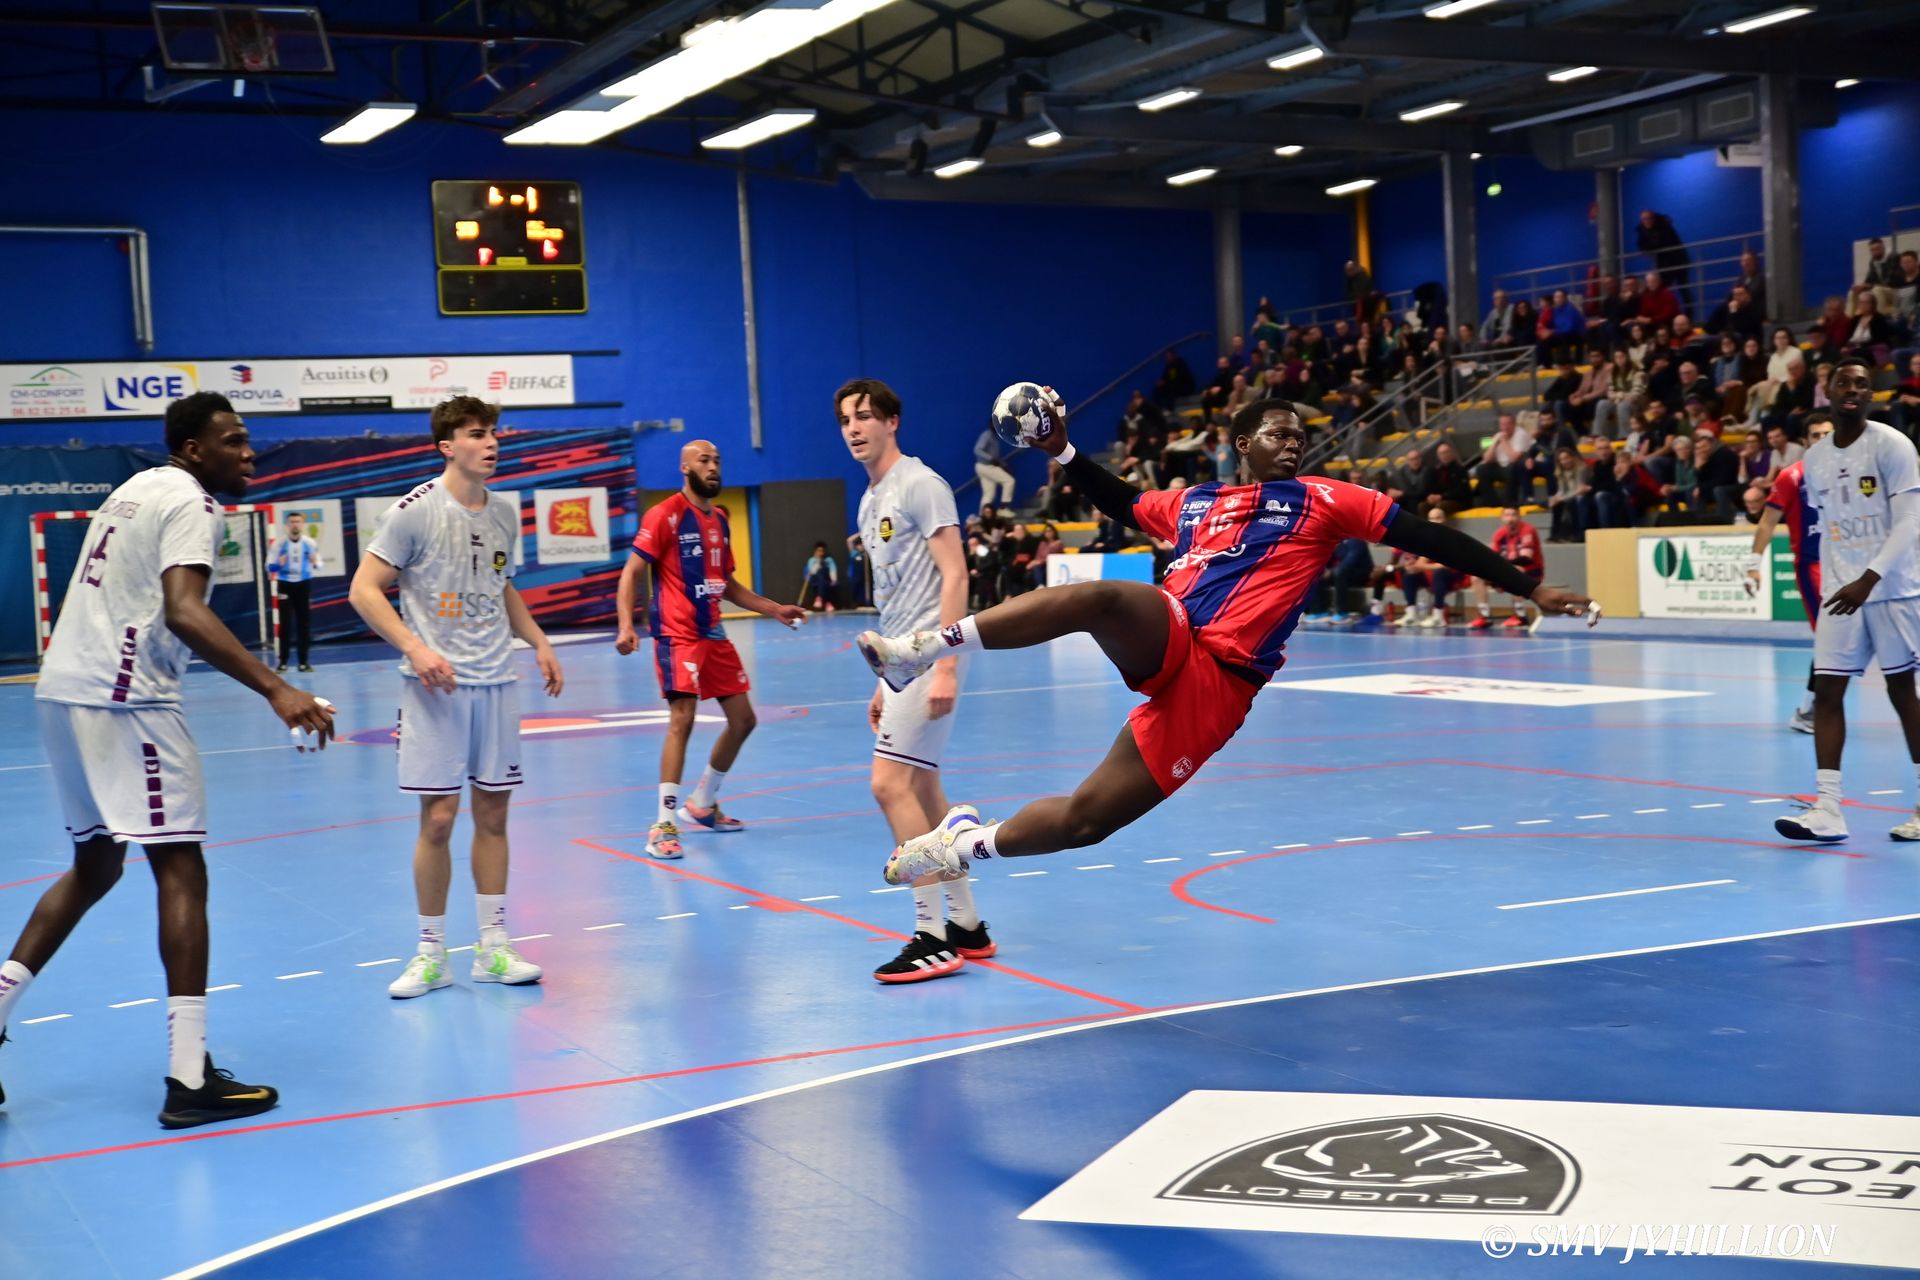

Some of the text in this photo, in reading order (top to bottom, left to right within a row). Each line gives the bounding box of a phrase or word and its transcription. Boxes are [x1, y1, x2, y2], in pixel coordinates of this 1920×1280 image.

[302, 366, 366, 381] Acuitis
[509, 376, 567, 390] EIFFAGE
[117, 376, 183, 398] NGE
[204, 389, 284, 400] ROVIA
[1209, 512, 1237, 535] 15
[710, 548, 721, 567] 11
[1700, 541, 1752, 560] Paysage
[1699, 563, 1746, 582] ADELIN
[1203, 1183, 1529, 1206] PEUGEOT
